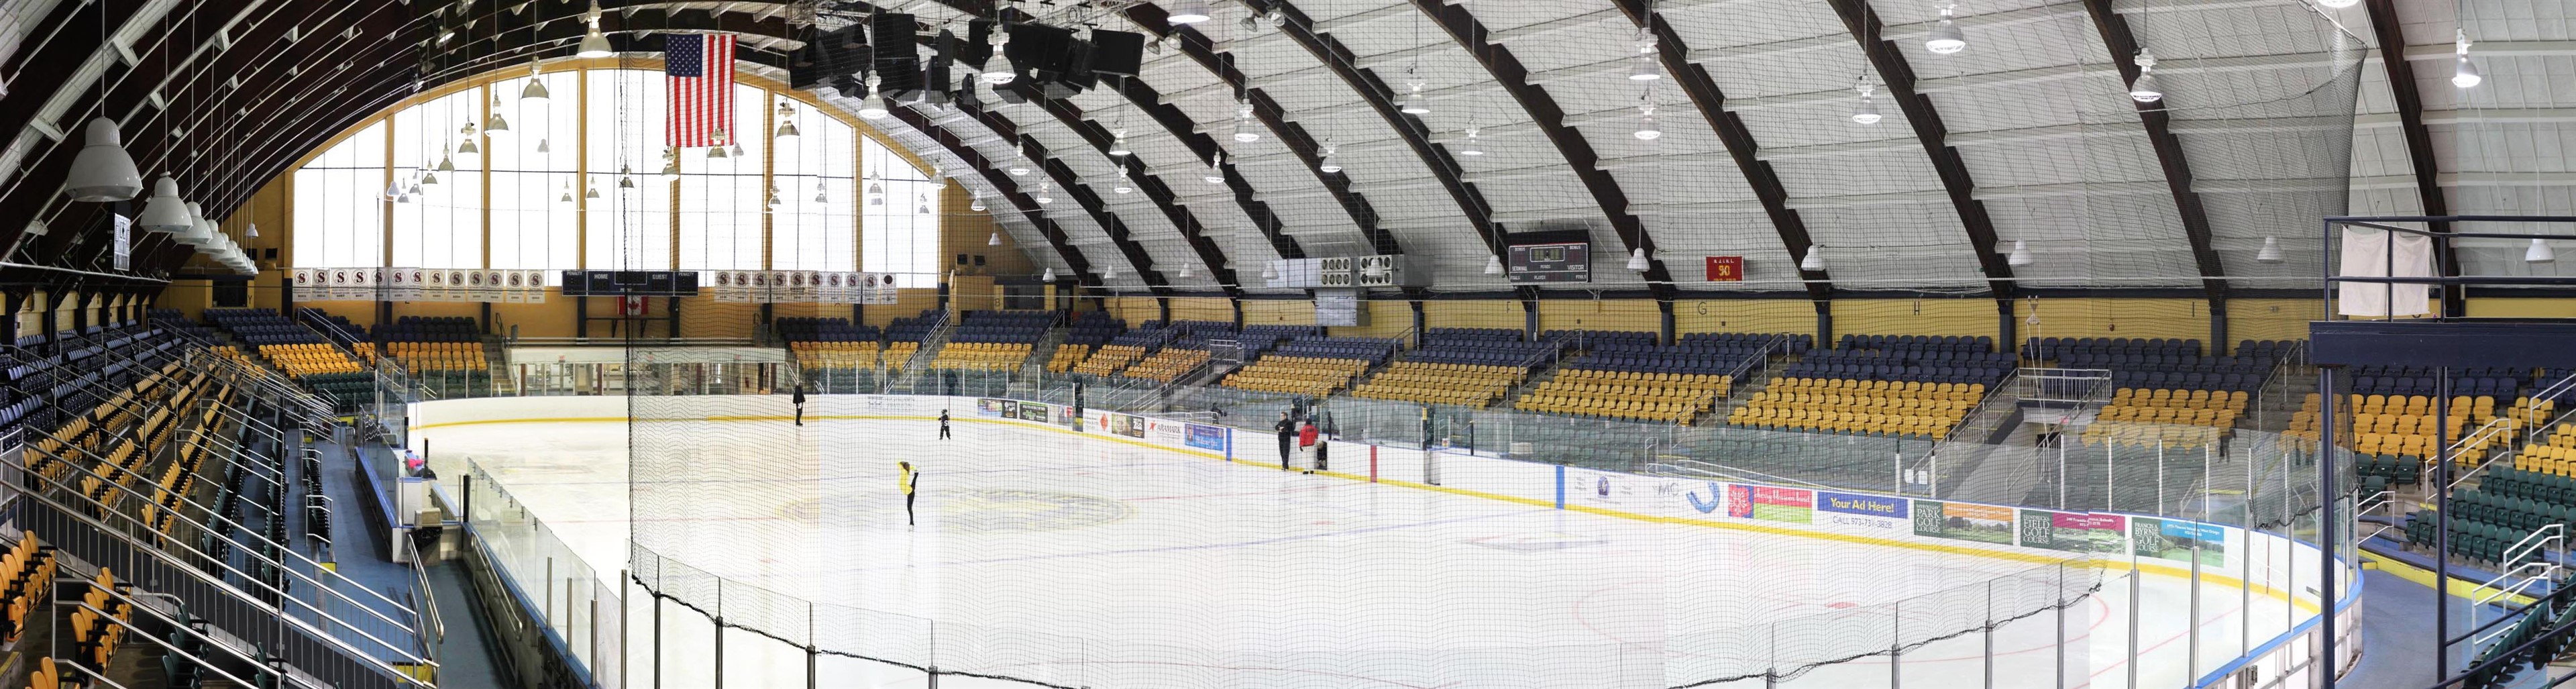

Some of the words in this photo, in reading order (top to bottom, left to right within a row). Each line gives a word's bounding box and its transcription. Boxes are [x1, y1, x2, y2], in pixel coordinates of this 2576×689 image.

[1719, 265, 1730, 276] 50
[299, 272, 306, 283] S
[318, 272, 325, 282] S
[337, 272, 345, 283] S
[356, 272, 364, 283] S
[395, 272, 402, 282] S
[433, 272, 440, 282] S
[453, 274, 460, 284] S
[473, 274, 480, 284] S
[492, 274, 498, 285] S
[512, 275, 519, 286] S
[532, 276, 539, 287] S
[720, 274, 727, 284] S
[739, 274, 745, 285] S
[757, 275, 763, 285] S
[776, 274, 783, 285] S
[794, 274, 801, 285] S
[813, 274, 820, 284] S
[831, 276, 837, 286] S
[849, 276, 856, 286] S
[867, 277, 873, 287] S
[1698, 302, 1707, 315] G
[1914, 301, 1920, 316] H
[1157, 423, 1181, 434] ARAMARK
[1831, 497, 1851, 509] Your
[1852, 499, 1865, 510] Ad
[1868, 500, 1894, 513] Here!
[1917, 509, 1941, 519] PARK
[1833, 516, 1849, 525] CALL
[1851, 517, 1892, 529] 973-731-3828
[1917, 517, 1941, 527] GOLF
[2023, 519, 2049, 527] FIELD
[1917, 525, 1941, 533] COURSE
[2023, 527, 2049, 537] GOLF
[2135, 527, 2159, 537] BYRNE
[2023, 536, 2050, 544] COURSE
[2136, 535, 2159, 546] GOLF
